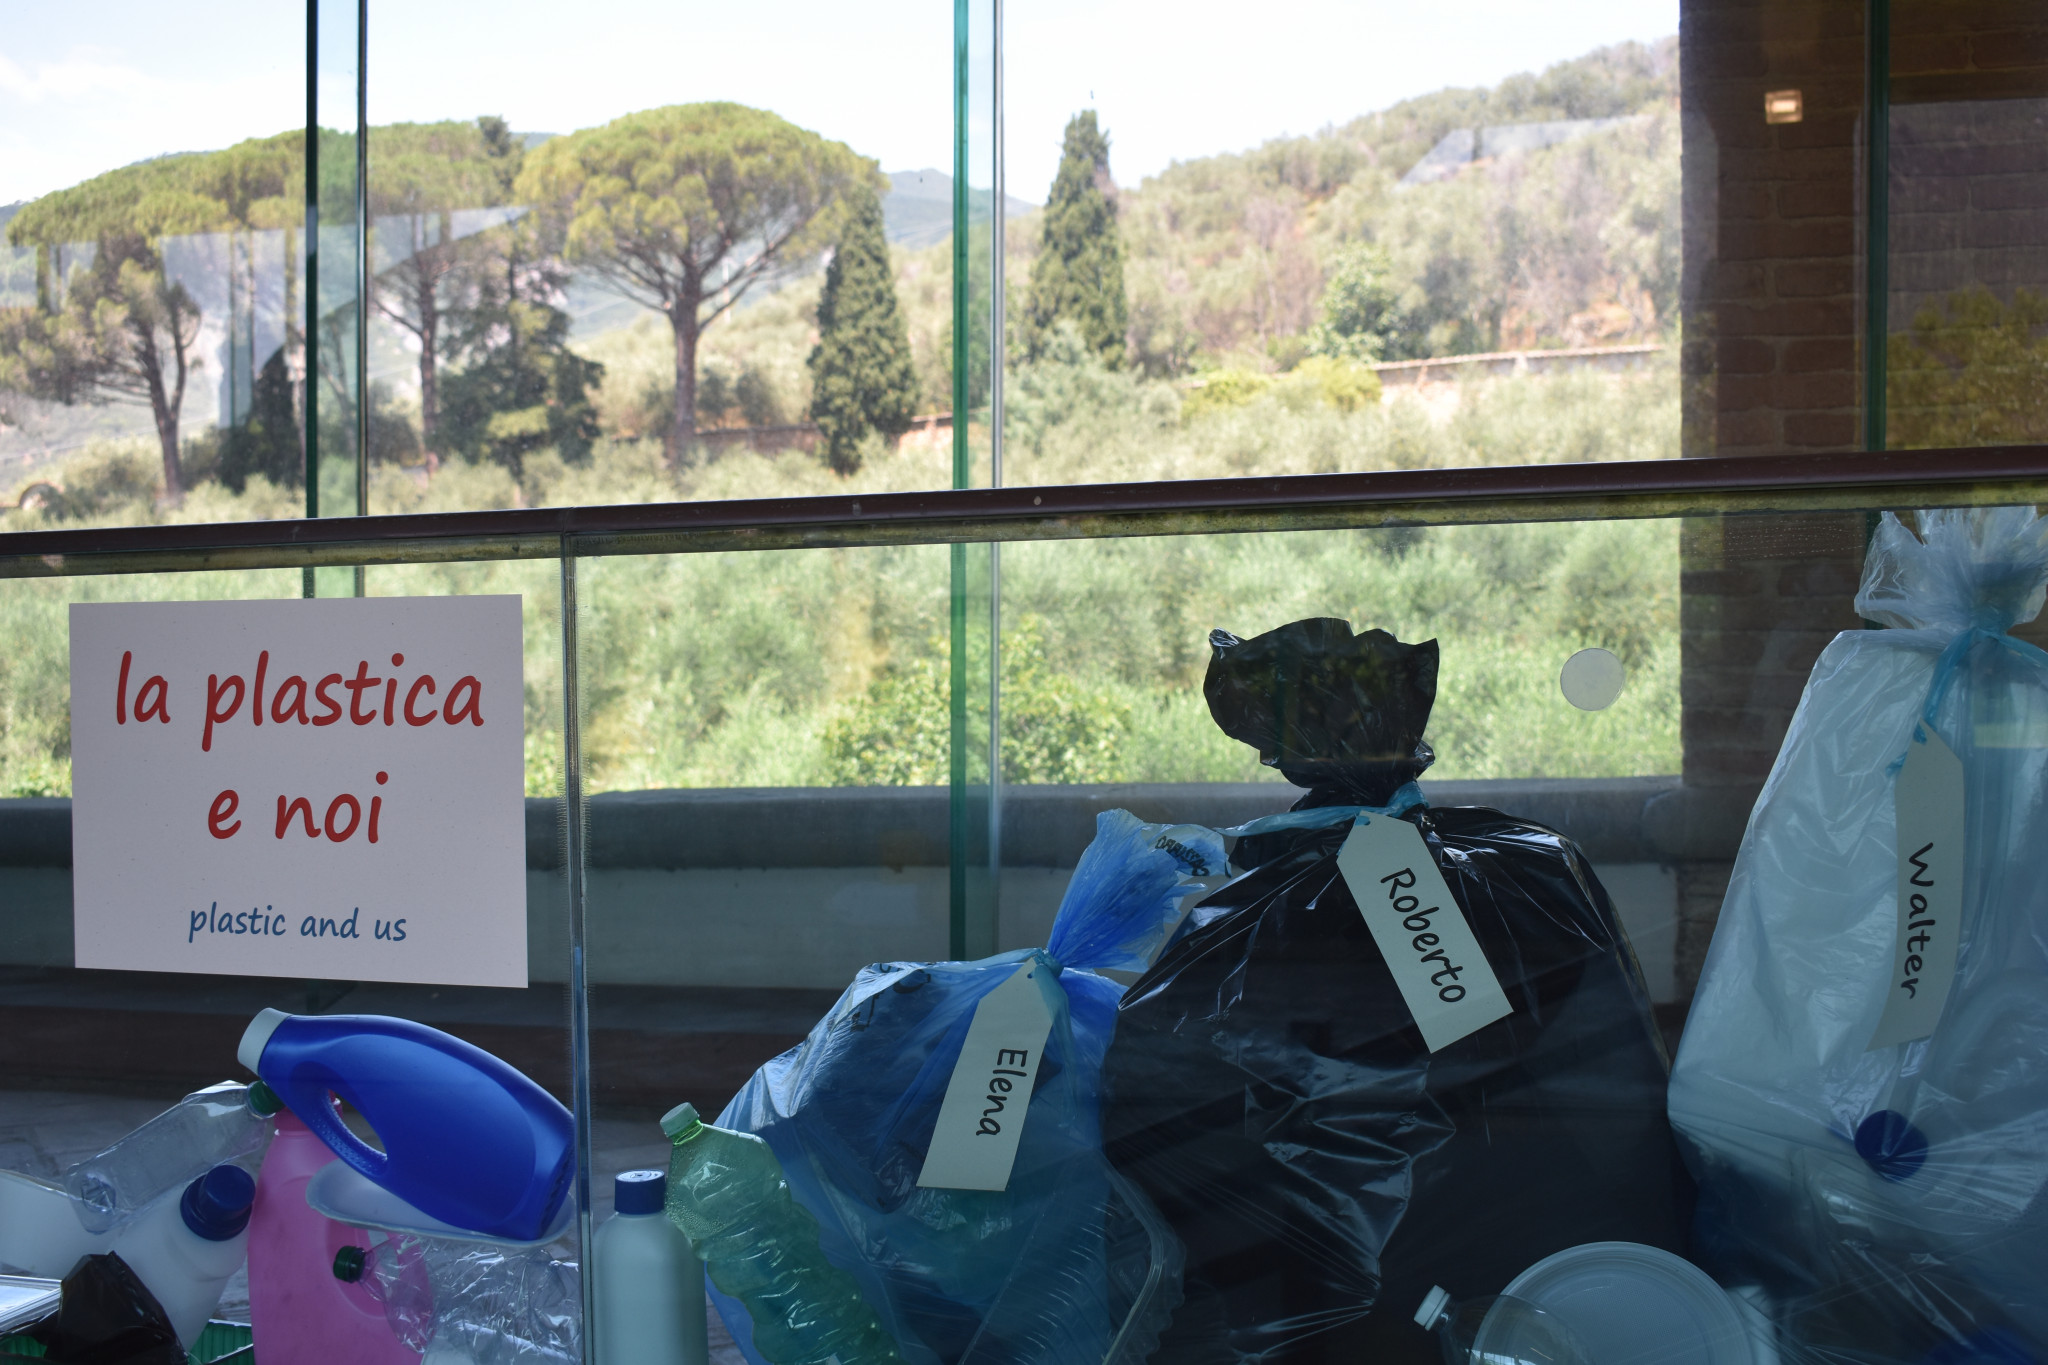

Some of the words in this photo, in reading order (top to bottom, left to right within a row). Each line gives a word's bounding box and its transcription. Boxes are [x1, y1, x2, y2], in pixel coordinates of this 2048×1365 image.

[118, 650, 172, 726] la
[202, 650, 485, 753] plastica
[208, 788, 242, 840] e
[274, 770, 391, 845] noi
[186, 900, 287, 945] plastic
[299, 906, 361, 941] and
[373, 917, 408, 944] us
[1380, 867, 1467, 1004] Roberto
[1901, 841, 1937, 1000] Walter
[975, 1048, 1030, 1138] Elena
